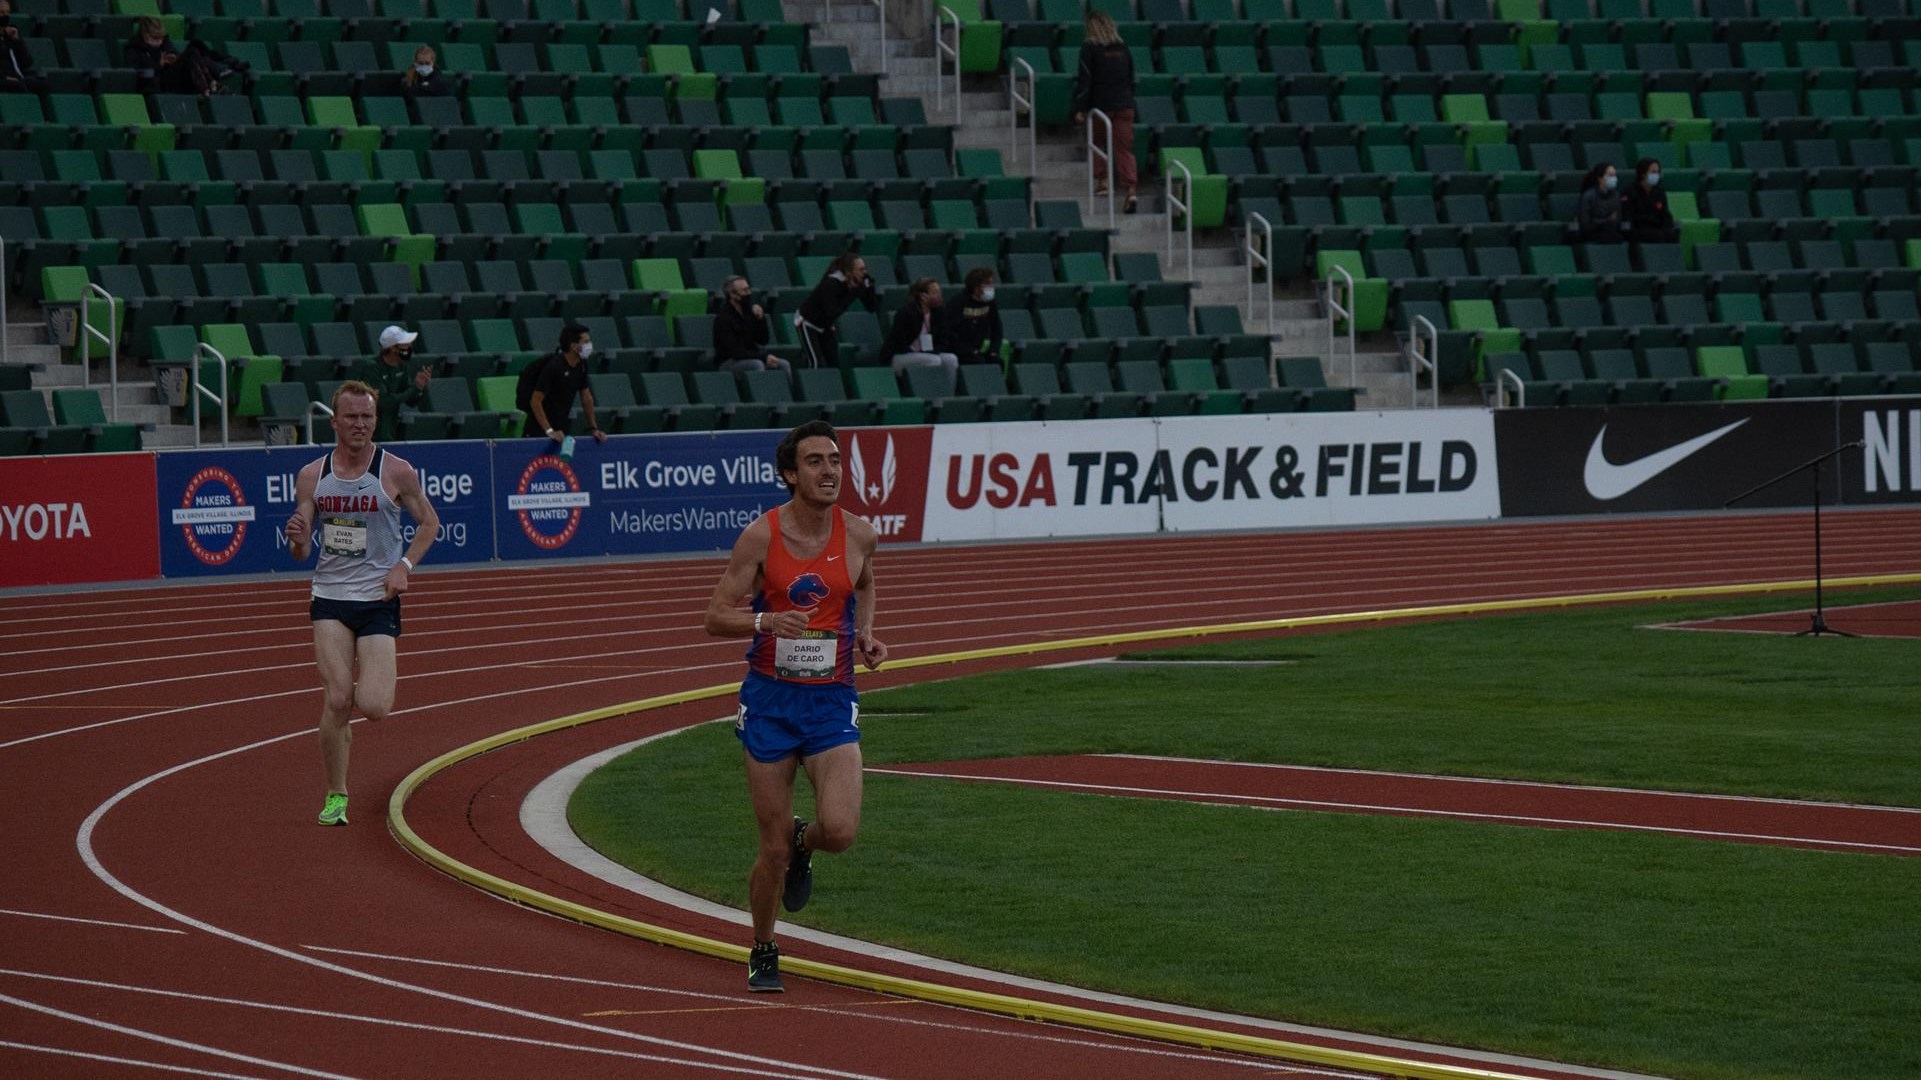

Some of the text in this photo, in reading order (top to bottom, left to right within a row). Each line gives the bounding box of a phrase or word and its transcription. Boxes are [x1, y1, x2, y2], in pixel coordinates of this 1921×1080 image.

[1863, 409, 1921, 492] NI
[601, 460, 640, 490] Elk
[644, 460, 716, 489] Grove
[946, 440, 1478, 510] USA TRACK & FIELD
[415, 468, 473, 503] lage
[530, 482, 567, 493] MAKERS
[195, 495, 231, 507] MAKERS
[317, 495, 380, 513] GONZAGA
[0, 502, 92, 541] YOTA
[530, 509, 568, 520] WANTED
[195, 524, 234, 535] WANTED
[859, 514, 907, 536] ATF
[334, 537, 353, 545] BATES
[336, 530, 353, 538] EVAN
[794, 645, 821, 653] DARIO
